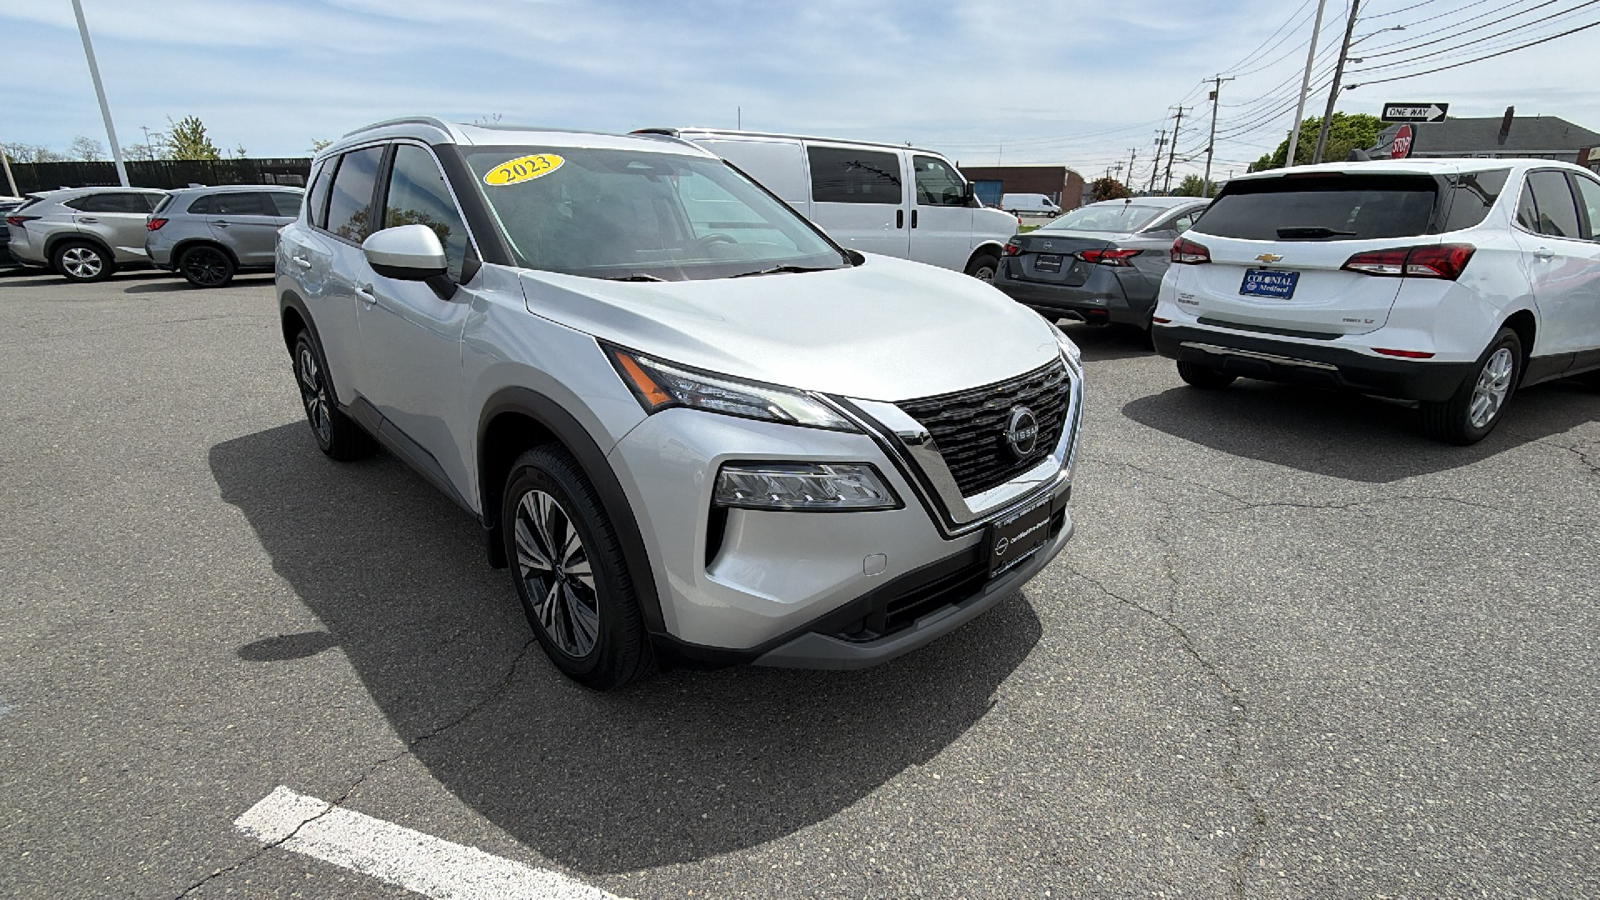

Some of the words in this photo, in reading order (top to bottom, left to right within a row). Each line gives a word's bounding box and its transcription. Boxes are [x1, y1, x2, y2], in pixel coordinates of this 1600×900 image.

[1389, 108, 1408, 116] ONE
[1410, 108, 1428, 116] WAY
[1392, 136, 1410, 153] STOP
[500, 156, 550, 182] 2023
[1247, 274, 1292, 286] COLONIAL
[1260, 284, 1289, 293] Medford
[1008, 425, 1038, 442] NISSAN
